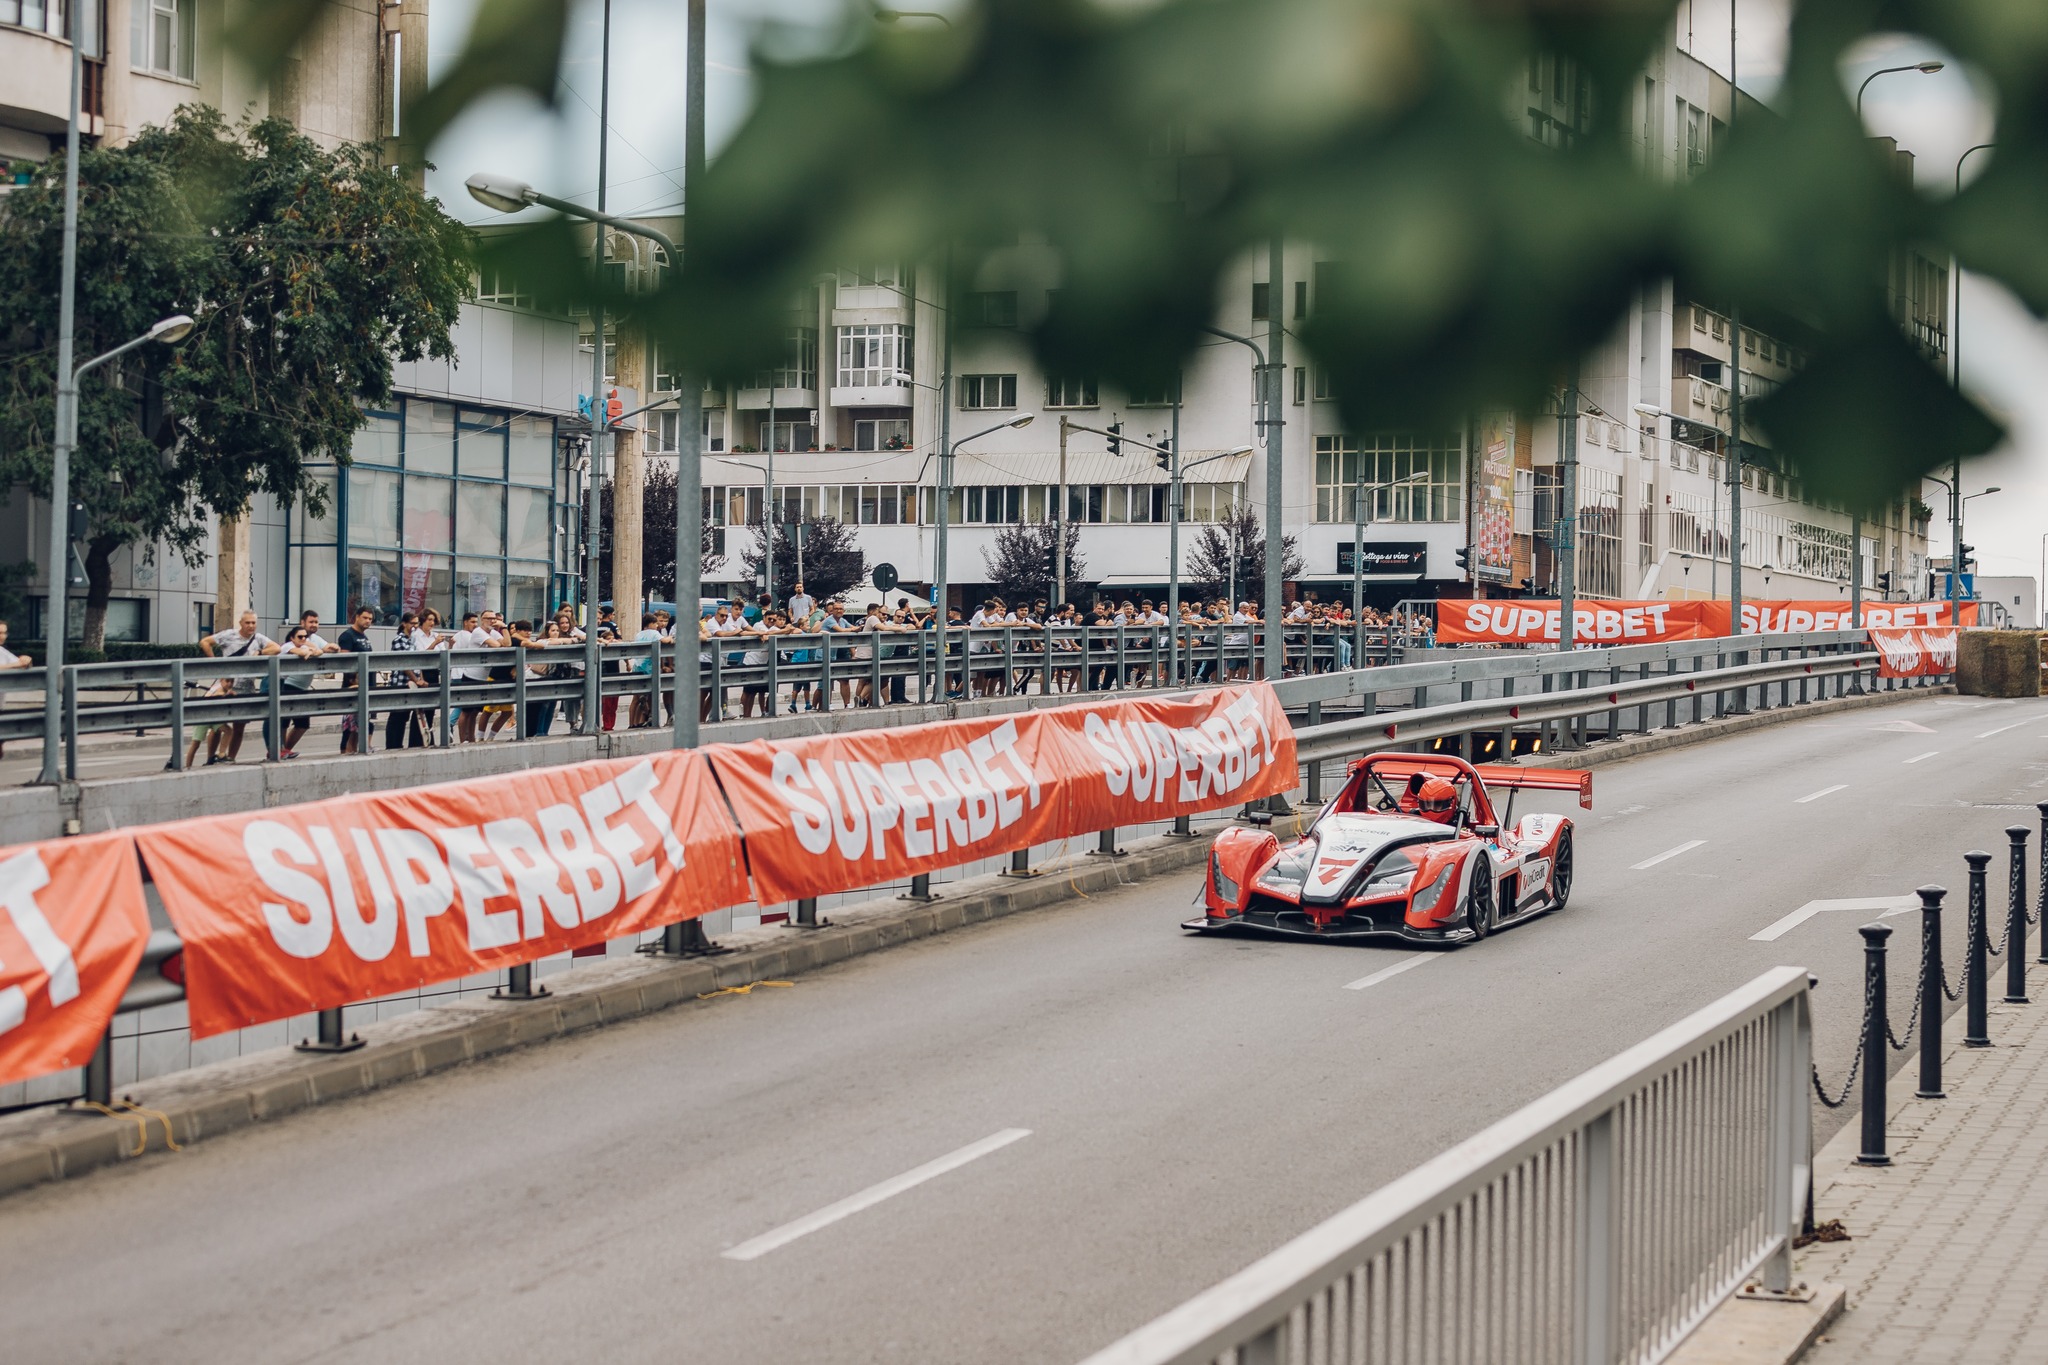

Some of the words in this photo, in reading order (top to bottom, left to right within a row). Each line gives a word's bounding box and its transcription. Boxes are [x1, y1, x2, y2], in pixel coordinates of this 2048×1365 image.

[1464, 603, 1671, 640] SUPERBET
[1740, 604, 1944, 635] SUPERBET
[771, 718, 1041, 861] SUPERBET
[1084, 689, 1275, 803] SUPERBET
[243, 759, 686, 963] SUPERBET
